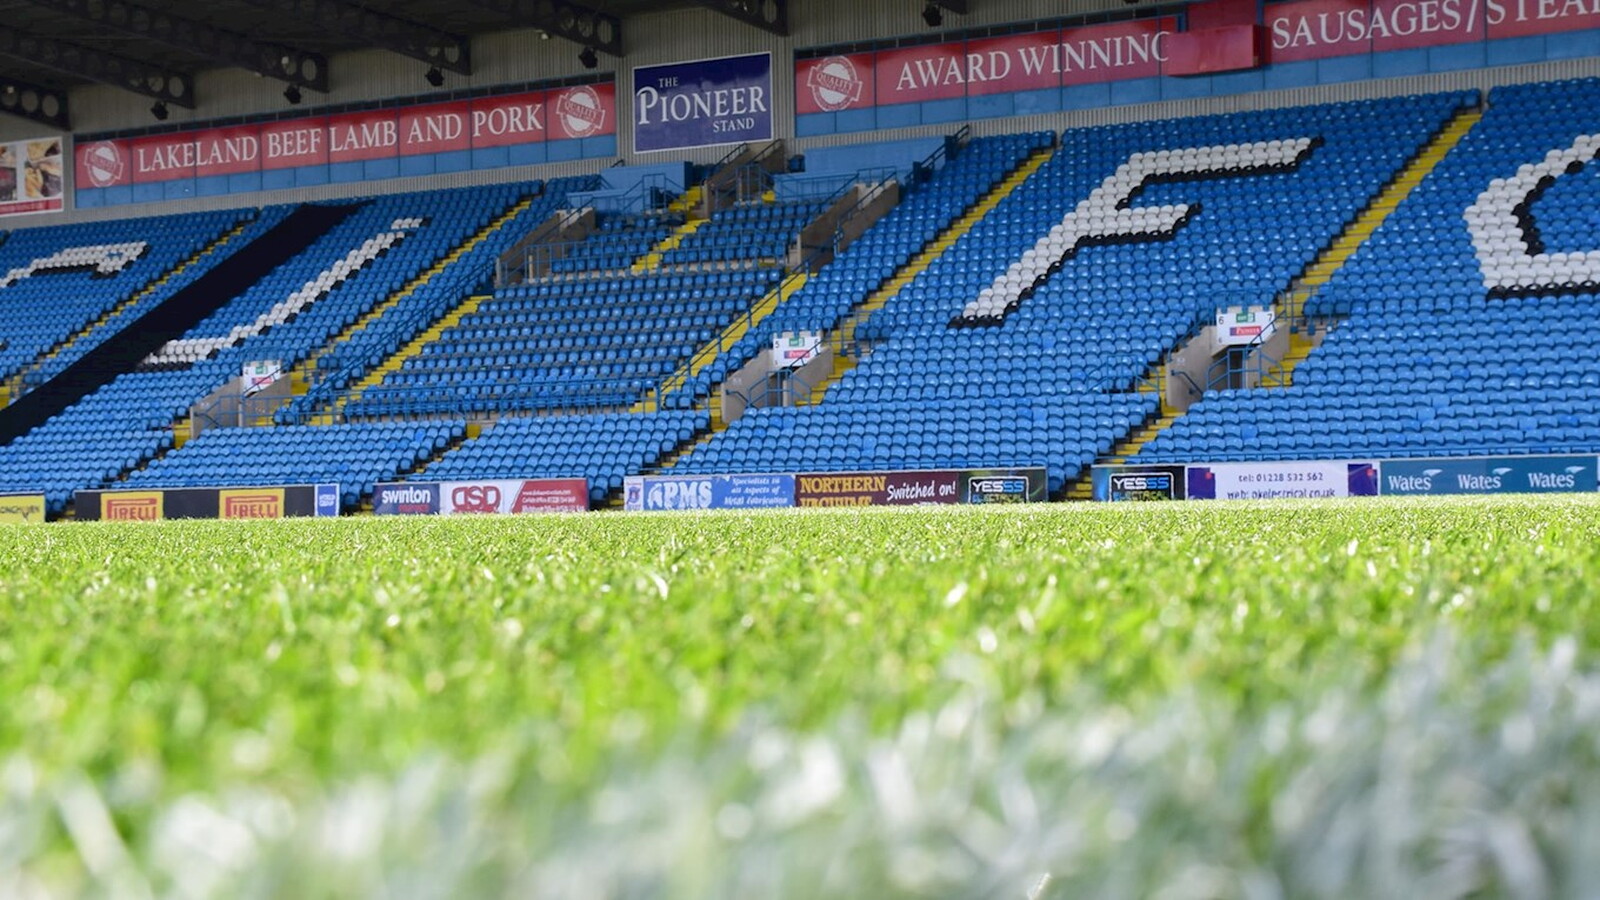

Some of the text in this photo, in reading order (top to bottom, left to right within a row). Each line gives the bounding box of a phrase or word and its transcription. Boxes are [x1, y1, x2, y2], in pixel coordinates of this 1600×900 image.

[1271, 0, 1600, 49] SAUSAGES/STEA
[896, 50, 1011, 91] AWARD
[658, 77, 679, 88] THE
[636, 86, 767, 125] PIONEER
[713, 117, 755, 133] STAND
[138, 136, 258, 172] LAKELAND
[268, 128, 322, 158] BEEF
[329, 120, 397, 152] LAMB
[407, 113, 462, 144] AND
[472, 103, 543, 137] PORK
[1267, 313, 1273, 322] 7
[800, 476, 886, 493] NORTHERN
[1113, 477, 1169, 490] YESSS
[1238, 472, 1323, 482] tel: 01228 532 562
[1388, 475, 1432, 491] Wates
[1458, 474, 1502, 490] Wates
[1528, 472, 1575, 489] Wates
[382, 486, 431, 504] swinton
[886, 480, 957, 501] Switched on!
[972, 480, 1025, 493] YESSS
[107, 498, 157, 520] PIRELLI
[225, 495, 279, 518] PIRELLI
